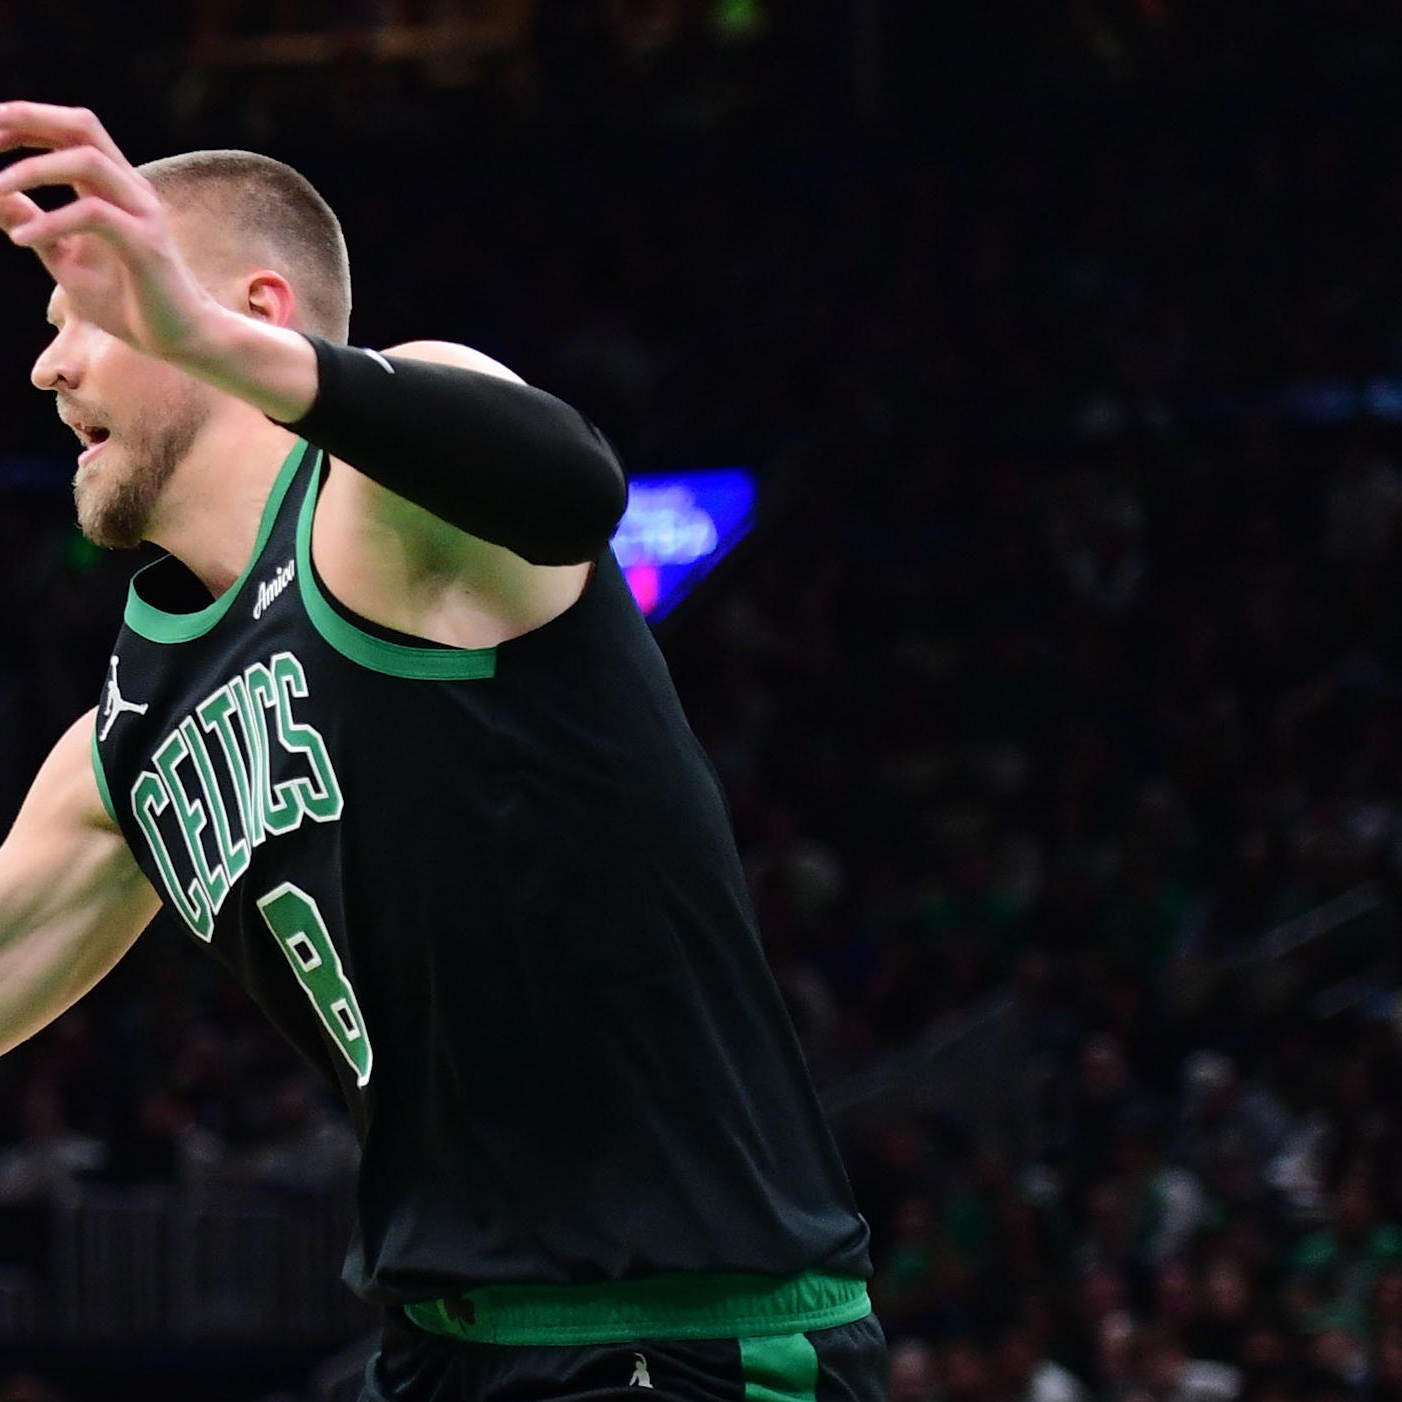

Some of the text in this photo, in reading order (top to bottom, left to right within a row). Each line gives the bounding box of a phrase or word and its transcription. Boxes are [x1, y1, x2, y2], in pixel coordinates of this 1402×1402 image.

[253, 559, 295, 620] Amica
[131, 651, 344, 943] CELTICS
[256, 881, 373, 1088] 8
